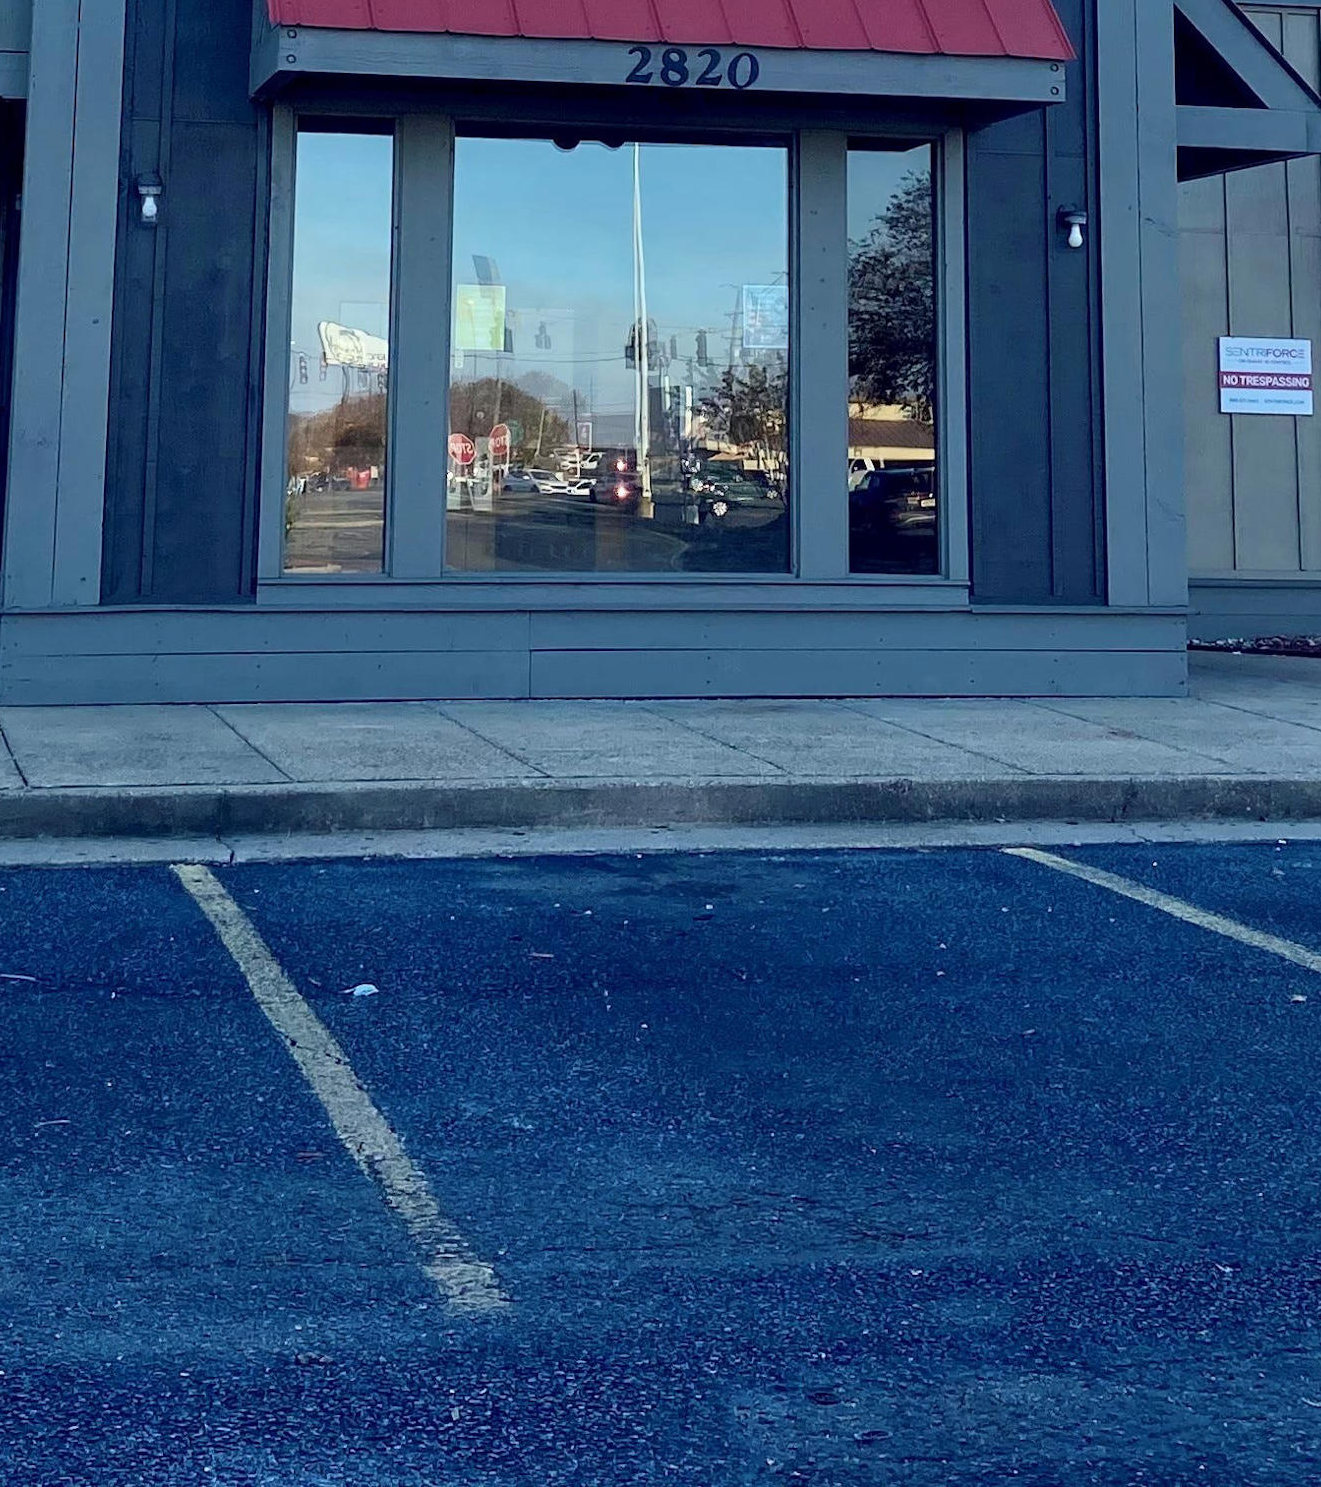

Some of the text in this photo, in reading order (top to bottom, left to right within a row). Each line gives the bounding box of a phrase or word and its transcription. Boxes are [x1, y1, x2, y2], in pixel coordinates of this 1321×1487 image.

[625, 46, 760, 89] 2820
[1223, 375, 1310, 387] NO TRESPASSING
